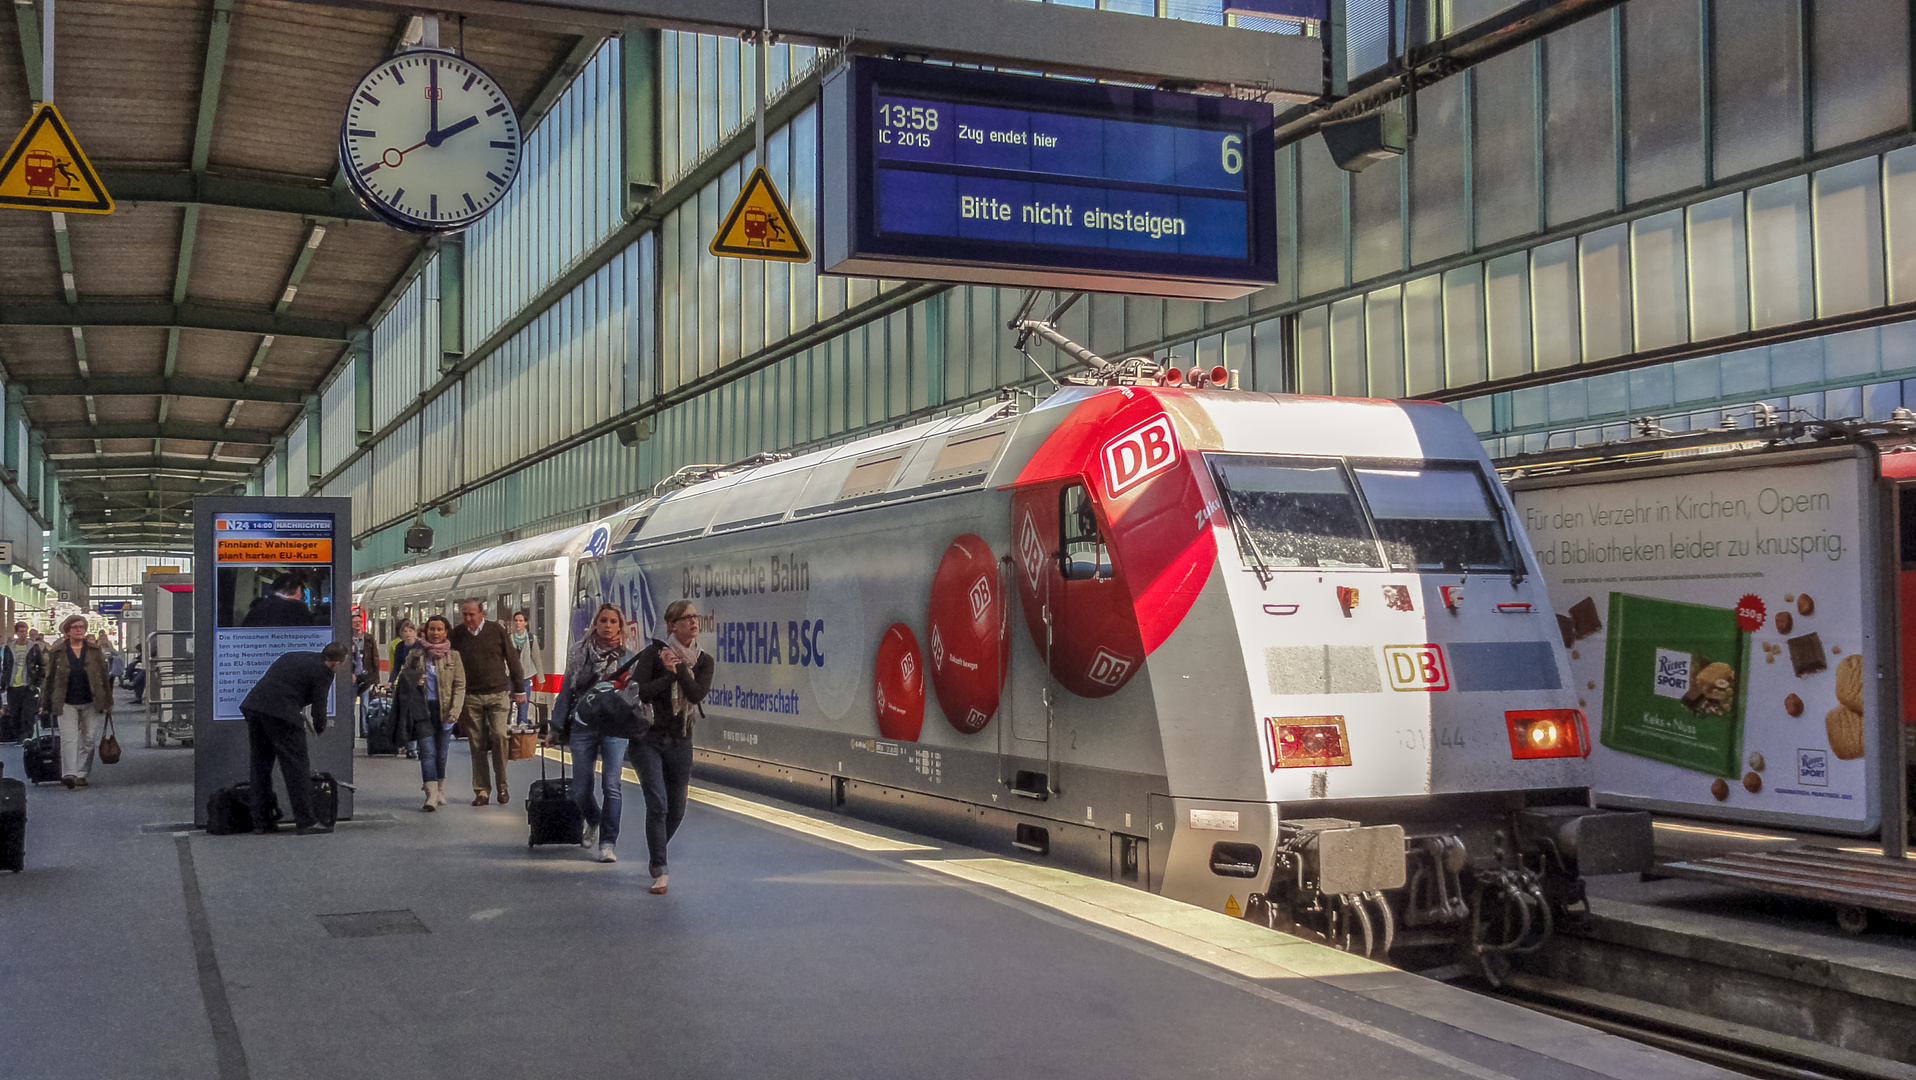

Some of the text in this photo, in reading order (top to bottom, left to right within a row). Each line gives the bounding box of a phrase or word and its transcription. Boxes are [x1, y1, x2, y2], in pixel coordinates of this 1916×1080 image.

[879, 103, 939, 131] 13:58
[878, 128, 931, 147] IC 2015
[957, 124, 1059, 148] Zug endet hier
[1220, 134, 1243, 175] 6
[961, 195, 1186, 240] Bitte nicht einsteigen
[1111, 424, 1171, 487] DB
[1525, 487, 1831, 531] Für den Verzehr in Kirchen, Opern
[226, 520, 250, 531] N24
[218, 541, 318, 550] Finnland: Wahlsieger
[218, 552, 243, 561] plant
[1536, 526, 1848, 566] nd Bibliotheken leider zu knusprig.
[682, 552, 811, 600] Die Deutsche Bahn
[970, 579, 991, 617] DB
[232, 643, 267, 651] verlangen
[716, 618, 825, 668] HERTHA BSC
[1091, 654, 1127, 686] DB
[1392, 651, 1441, 684] DB
[1657, 674, 1687, 690] SPORT
[707, 683, 733, 708] starke
[735, 684, 800, 716] Partnerschaft
[967, 710, 986, 728] DB
[1800, 769, 1825, 778] SPORT
